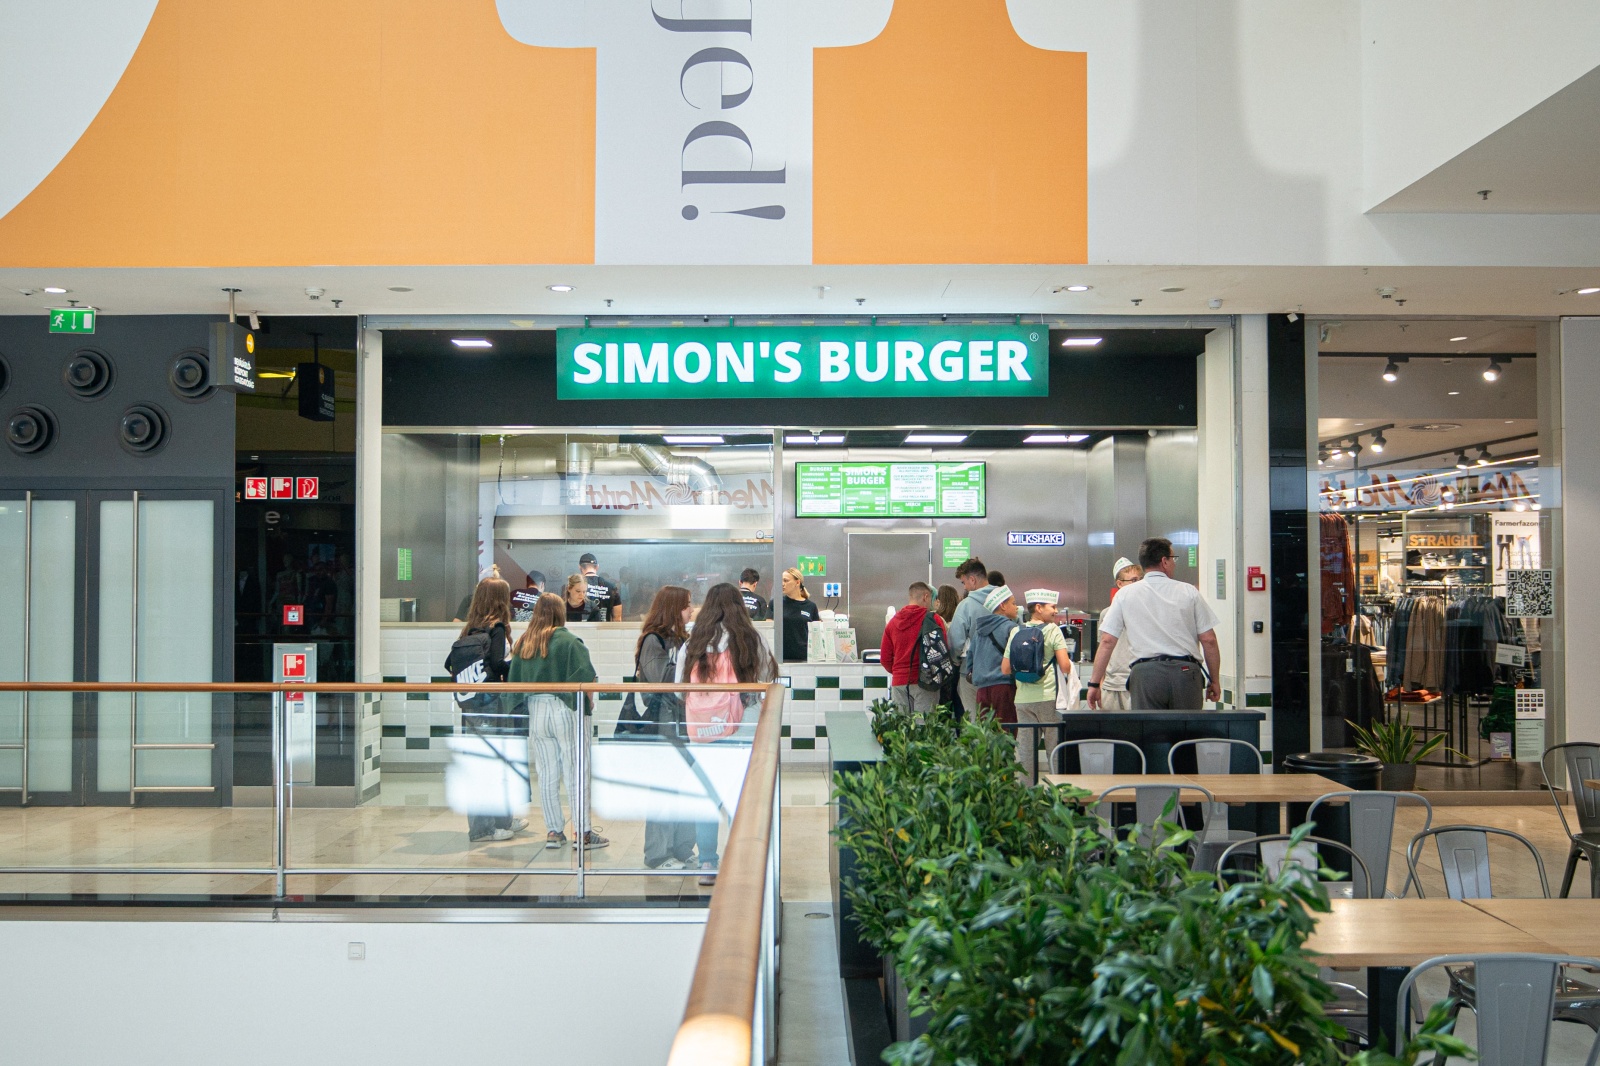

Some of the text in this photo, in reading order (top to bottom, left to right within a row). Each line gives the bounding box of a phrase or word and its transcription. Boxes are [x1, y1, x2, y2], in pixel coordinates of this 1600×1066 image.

[573, 340, 1032, 384] SIMON'S BURGER
[846, 476, 886, 485] BURGER
[1010, 534, 1062, 543] MILKSHAKE
[1409, 534, 1479, 546] STRAIGHT
[456, 659, 488, 683] NIKE
